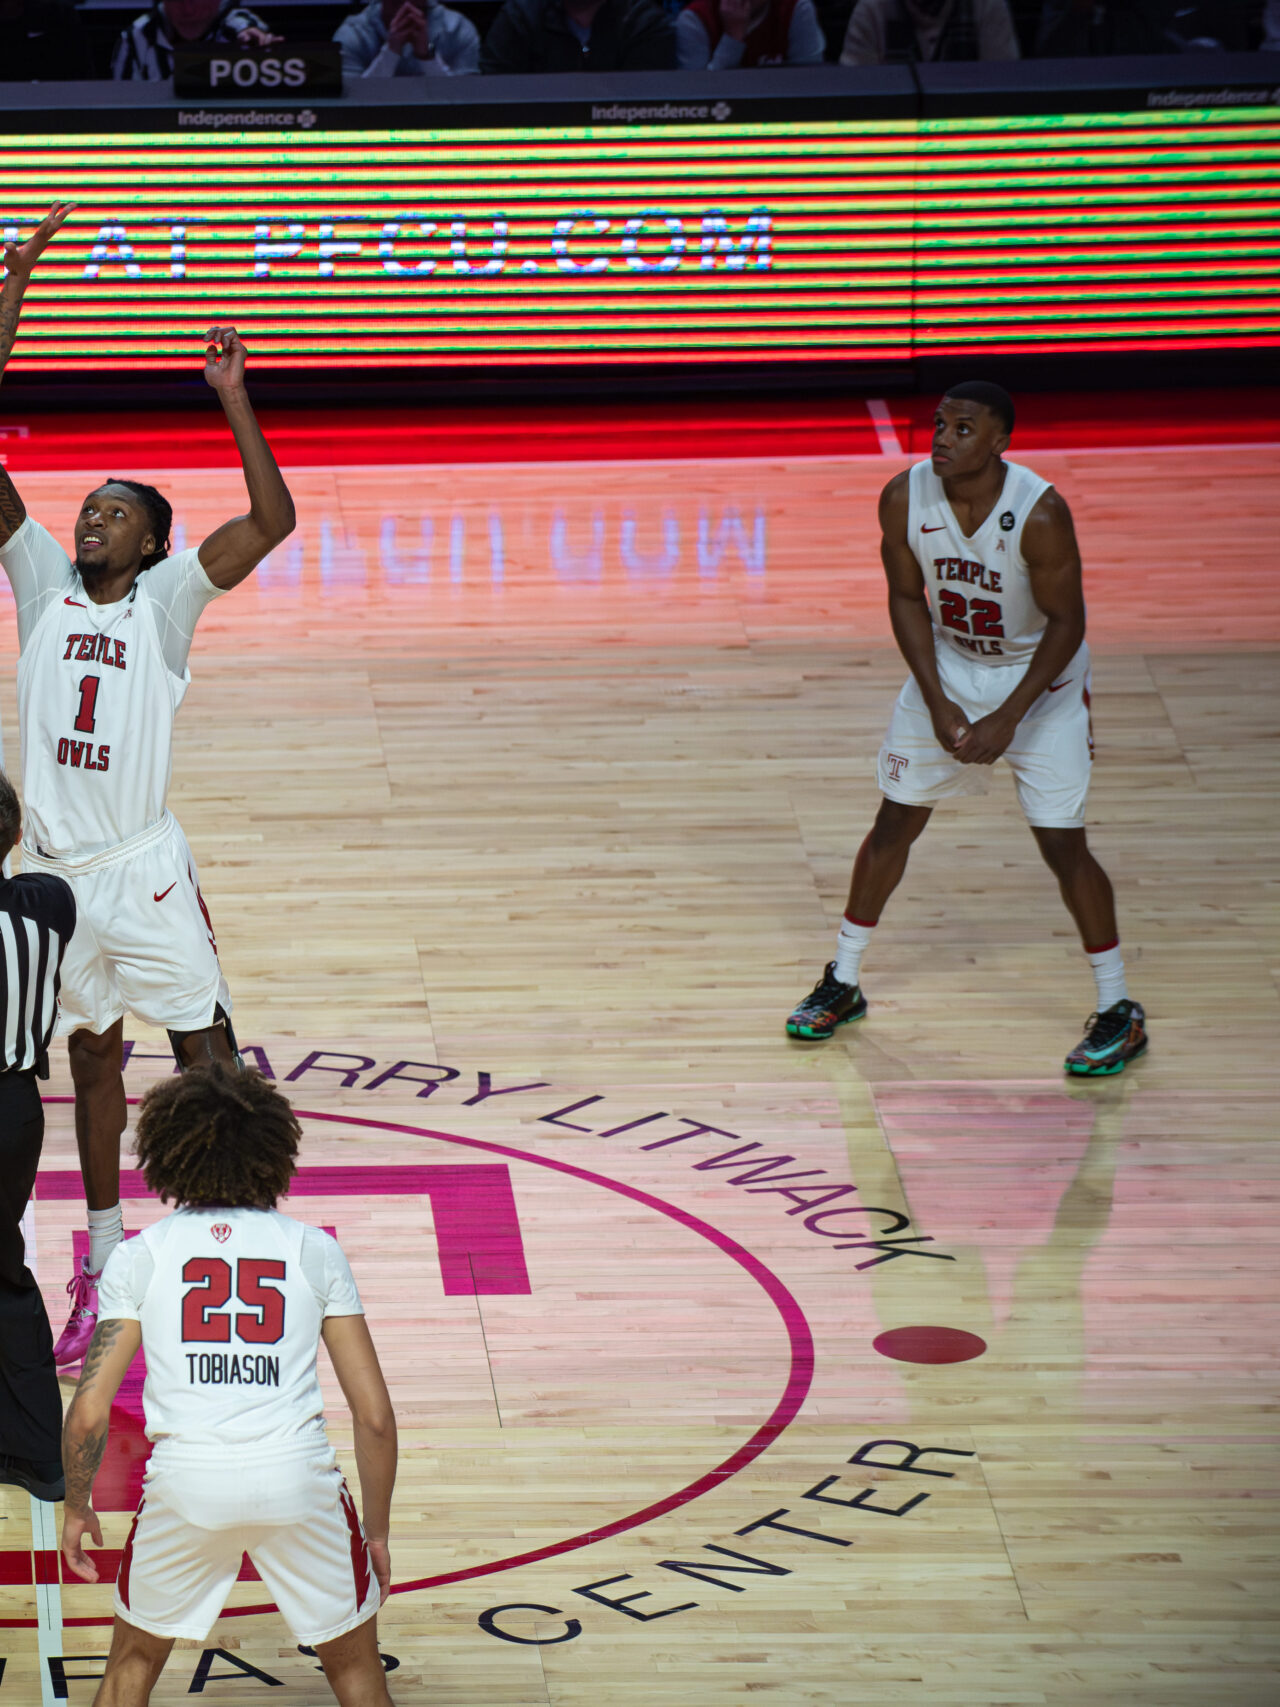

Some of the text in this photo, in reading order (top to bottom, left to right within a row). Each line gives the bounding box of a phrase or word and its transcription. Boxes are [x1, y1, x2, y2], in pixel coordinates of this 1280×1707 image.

[210, 58, 306, 87] POSS
[178, 110, 295, 128] Independence
[592, 103, 709, 121] Independence
[82, 217, 207, 279] AT
[934, 557, 1003, 593] TEMPLE
[938, 588, 1005, 638] 22
[74, 674, 100, 734] 1
[57, 737, 111, 771] OWLS
[536, 1095, 957, 1271] LITWACK
[181, 1256, 287, 1345] 25
[185, 1353, 280, 1387] TOBIASON
[477, 1438, 976, 1645] CENTER
